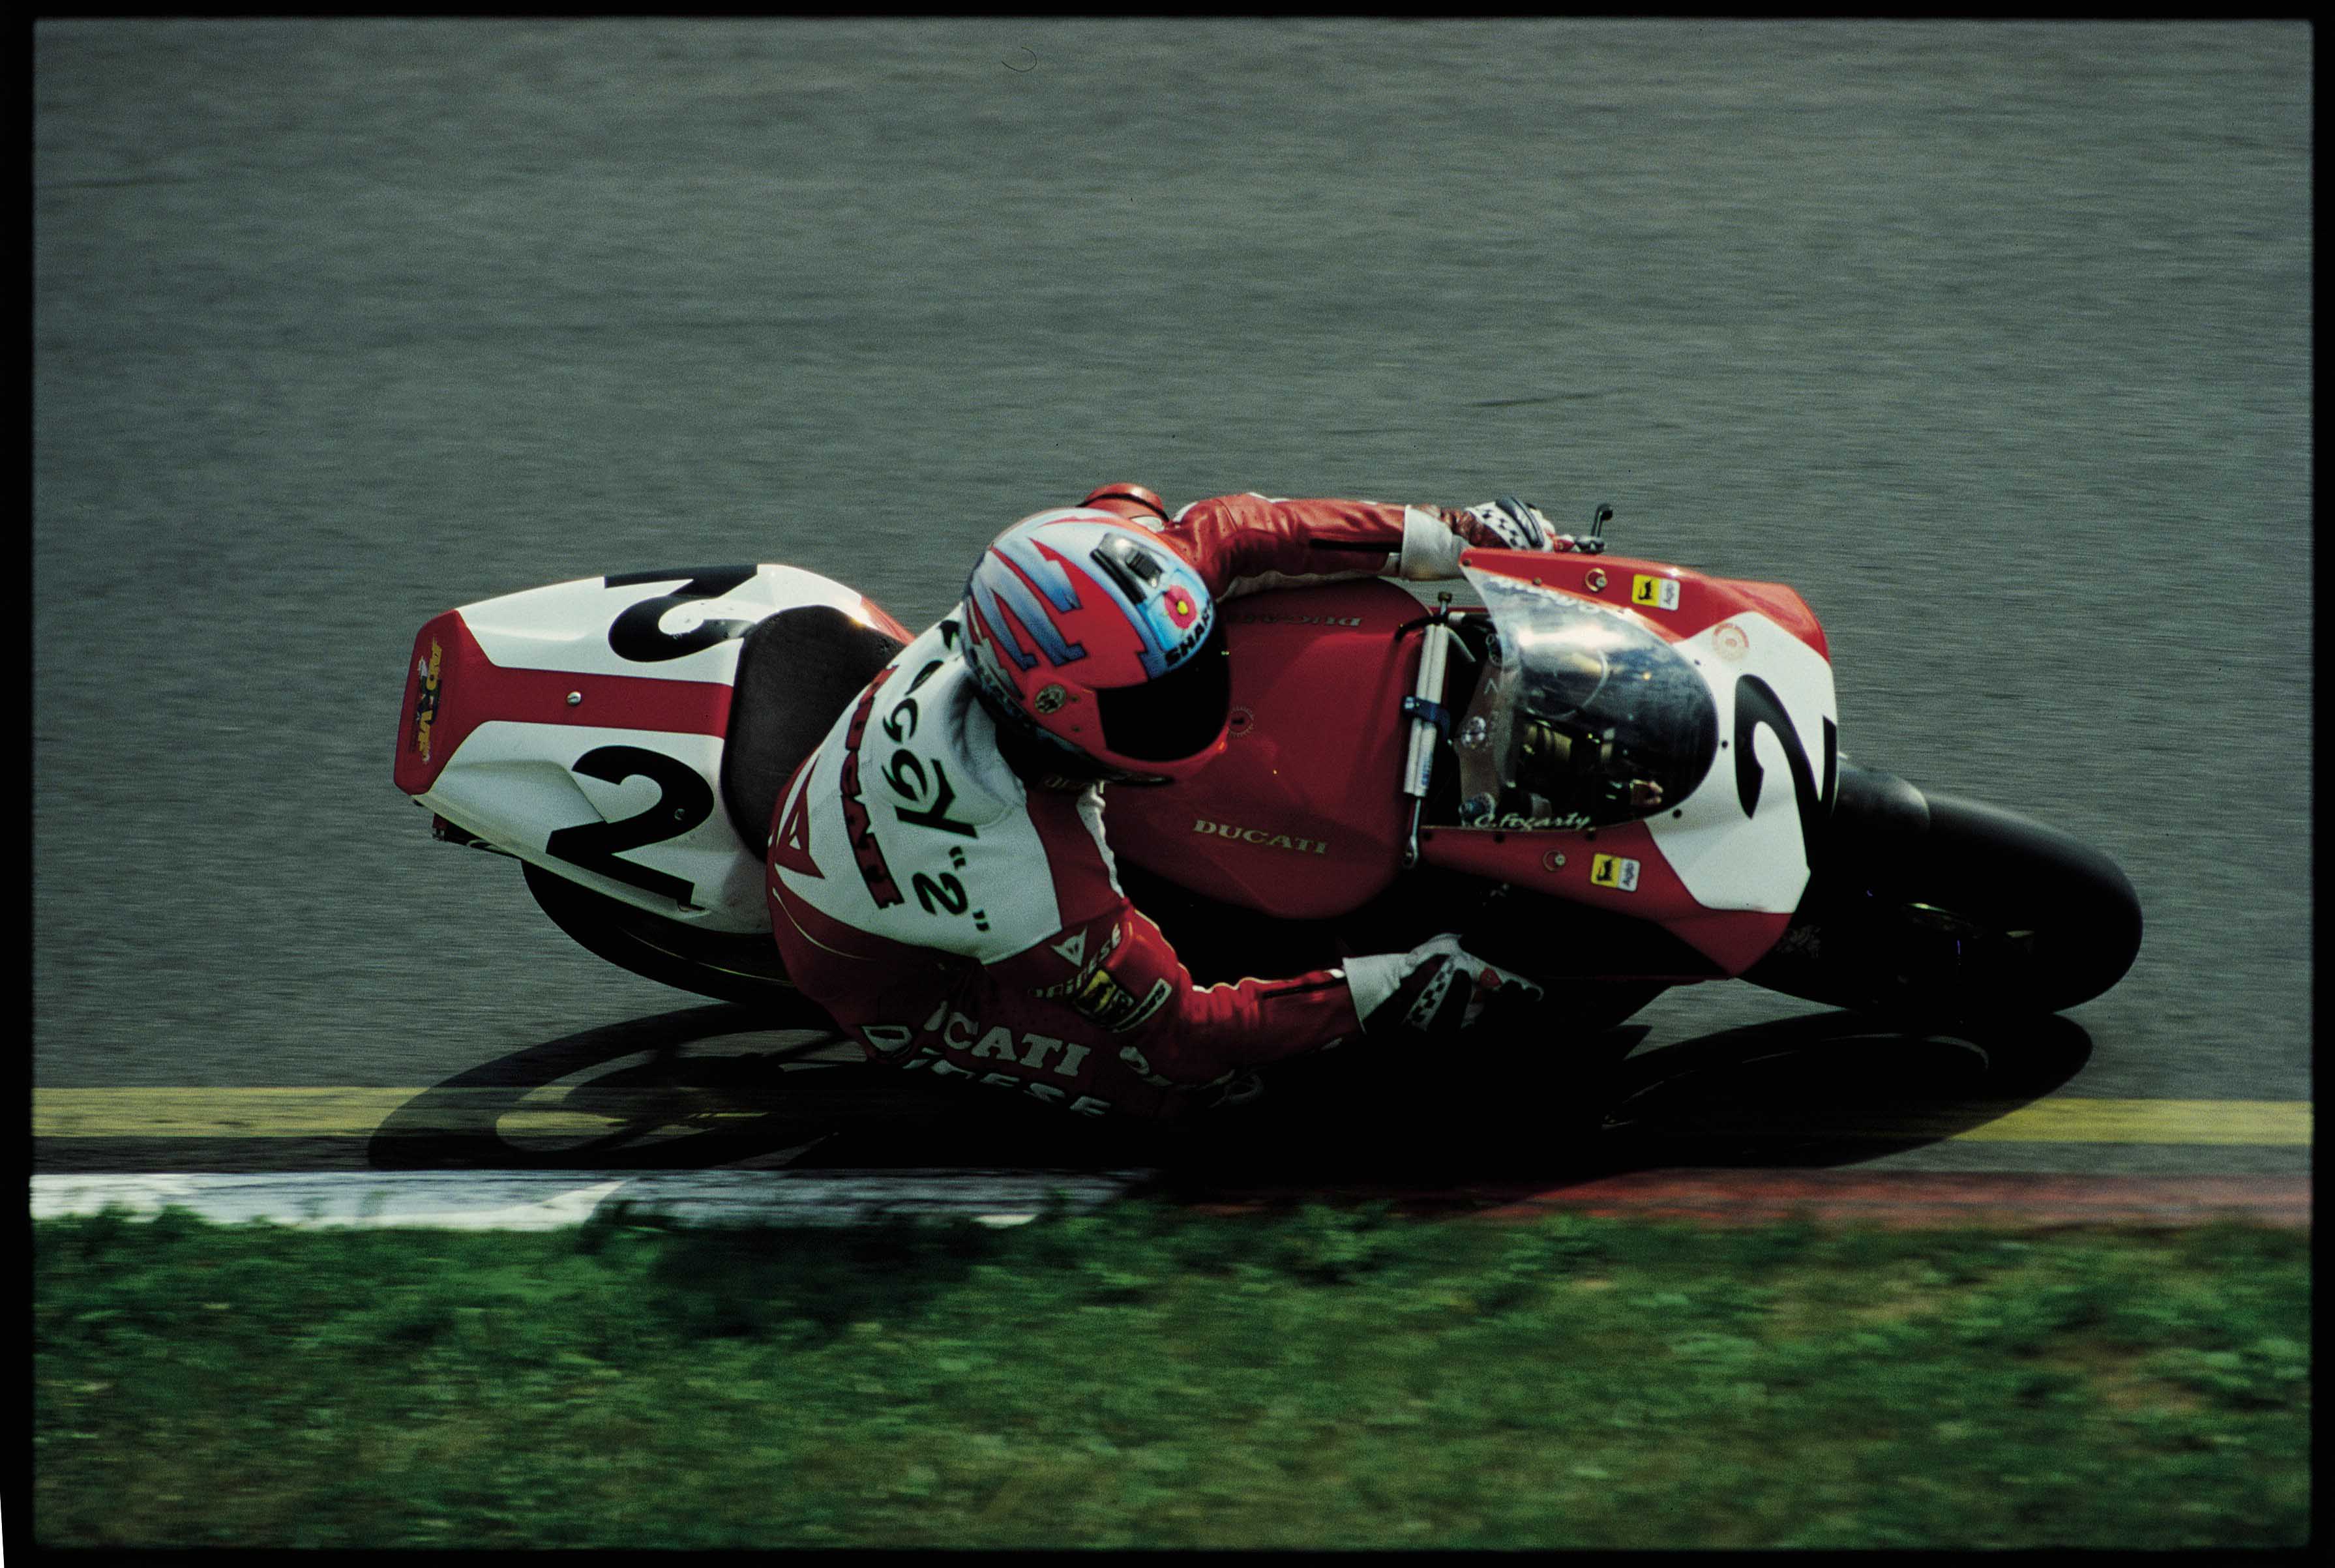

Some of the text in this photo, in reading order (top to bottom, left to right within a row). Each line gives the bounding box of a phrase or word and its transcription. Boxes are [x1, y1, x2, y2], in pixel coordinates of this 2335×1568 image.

[604, 563, 758, 662] 2
[1734, 673, 1837, 819] 2
[545, 745, 715, 910] 2
[1192, 819, 1327, 855] DUCATI
